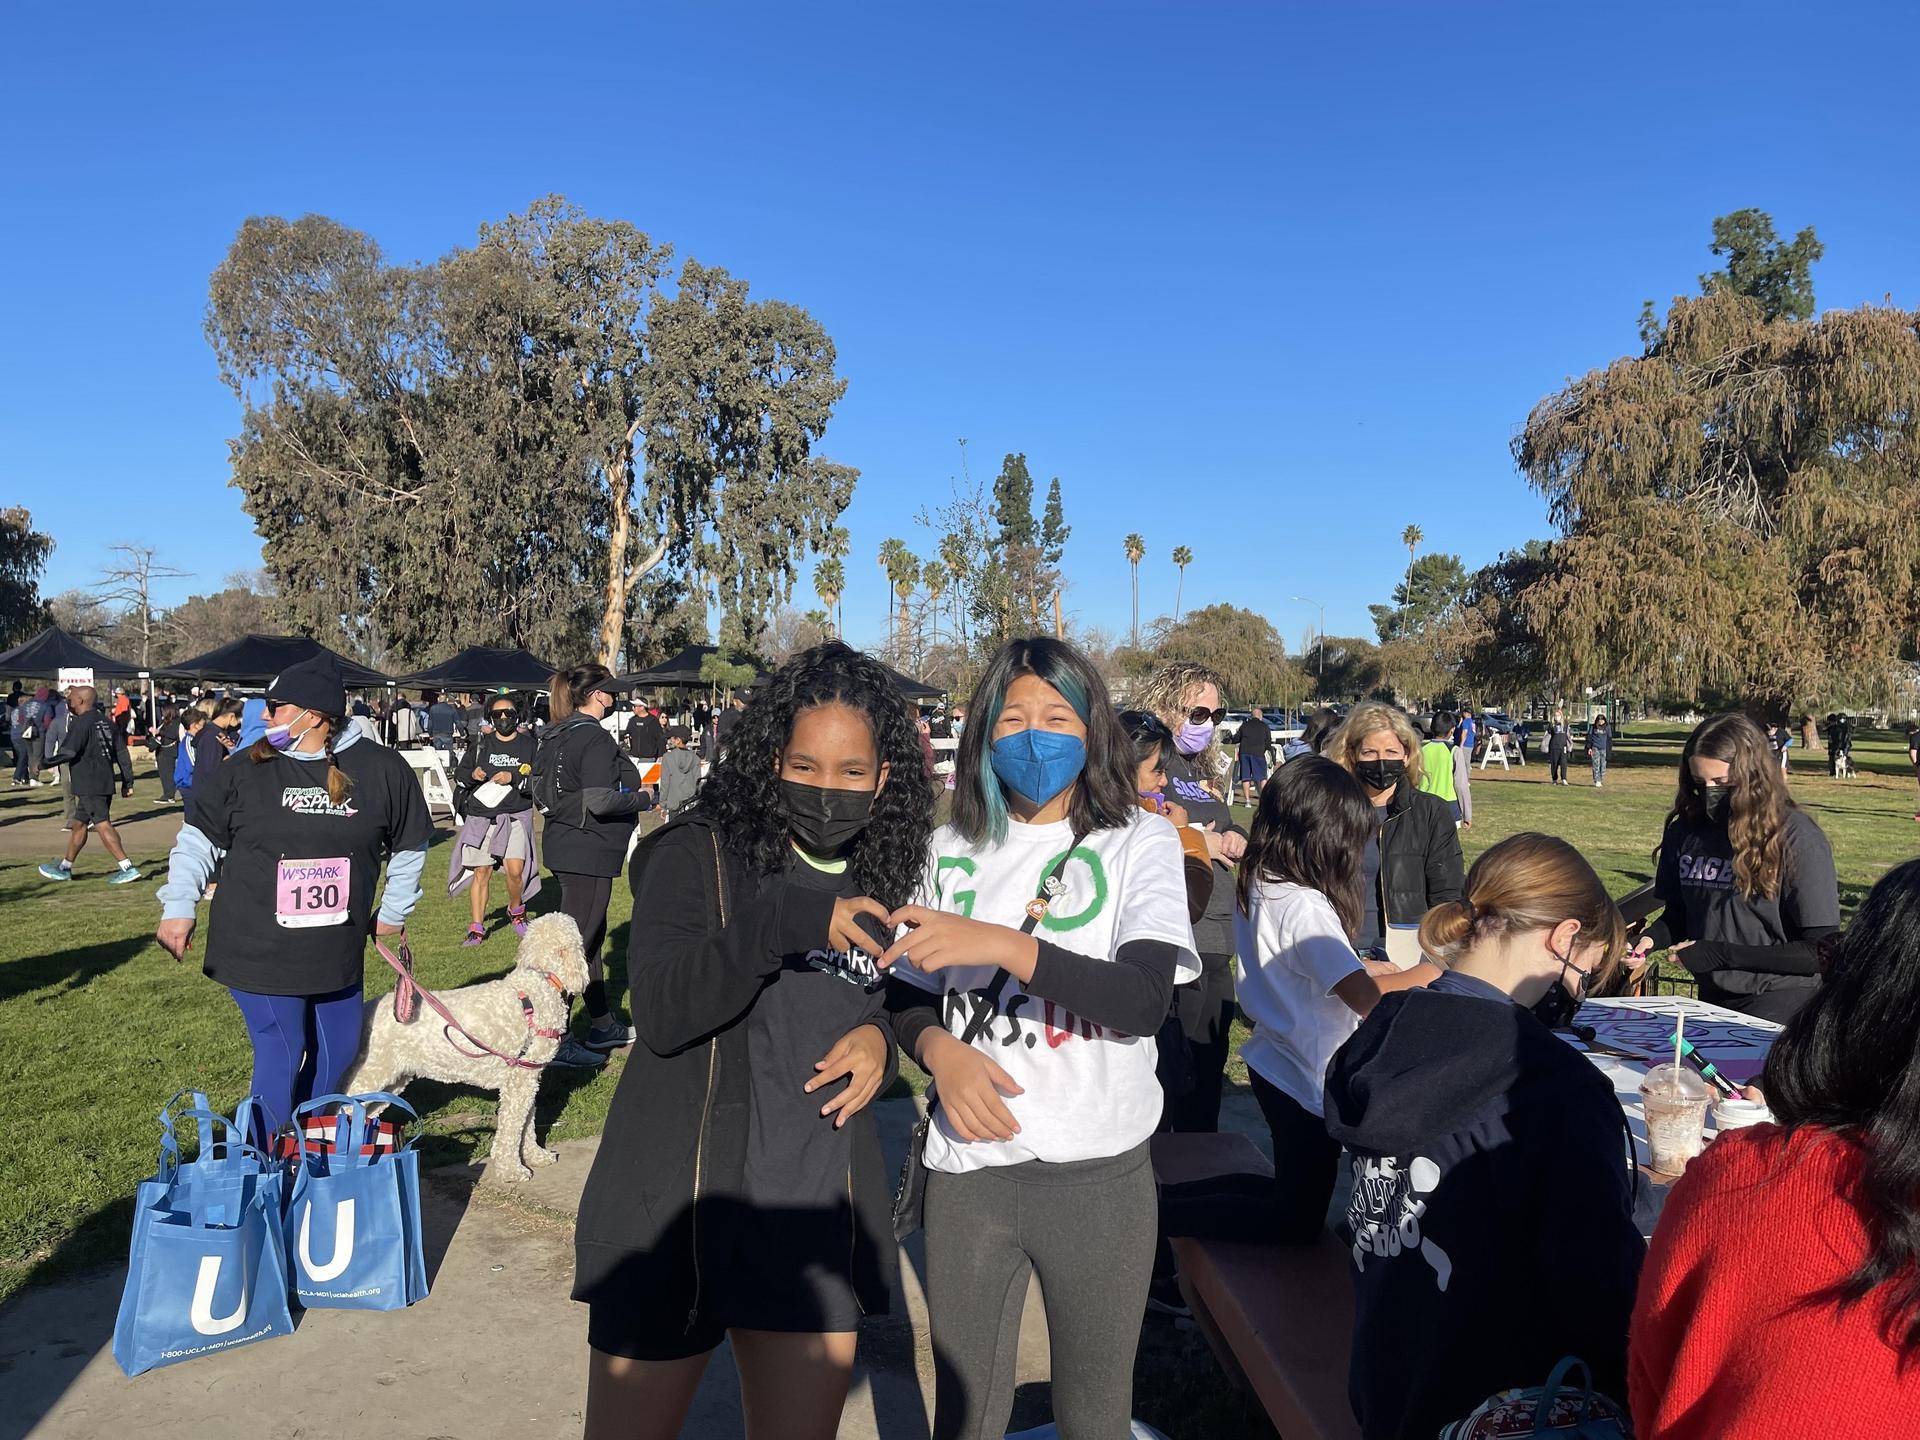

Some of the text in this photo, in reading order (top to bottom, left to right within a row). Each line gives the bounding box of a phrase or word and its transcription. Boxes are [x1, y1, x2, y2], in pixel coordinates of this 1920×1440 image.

[1679, 854, 1734, 884] SAGE
[291, 884, 340, 910] 130
[298, 1199, 355, 1282] U
[190, 1256, 247, 1336] U
